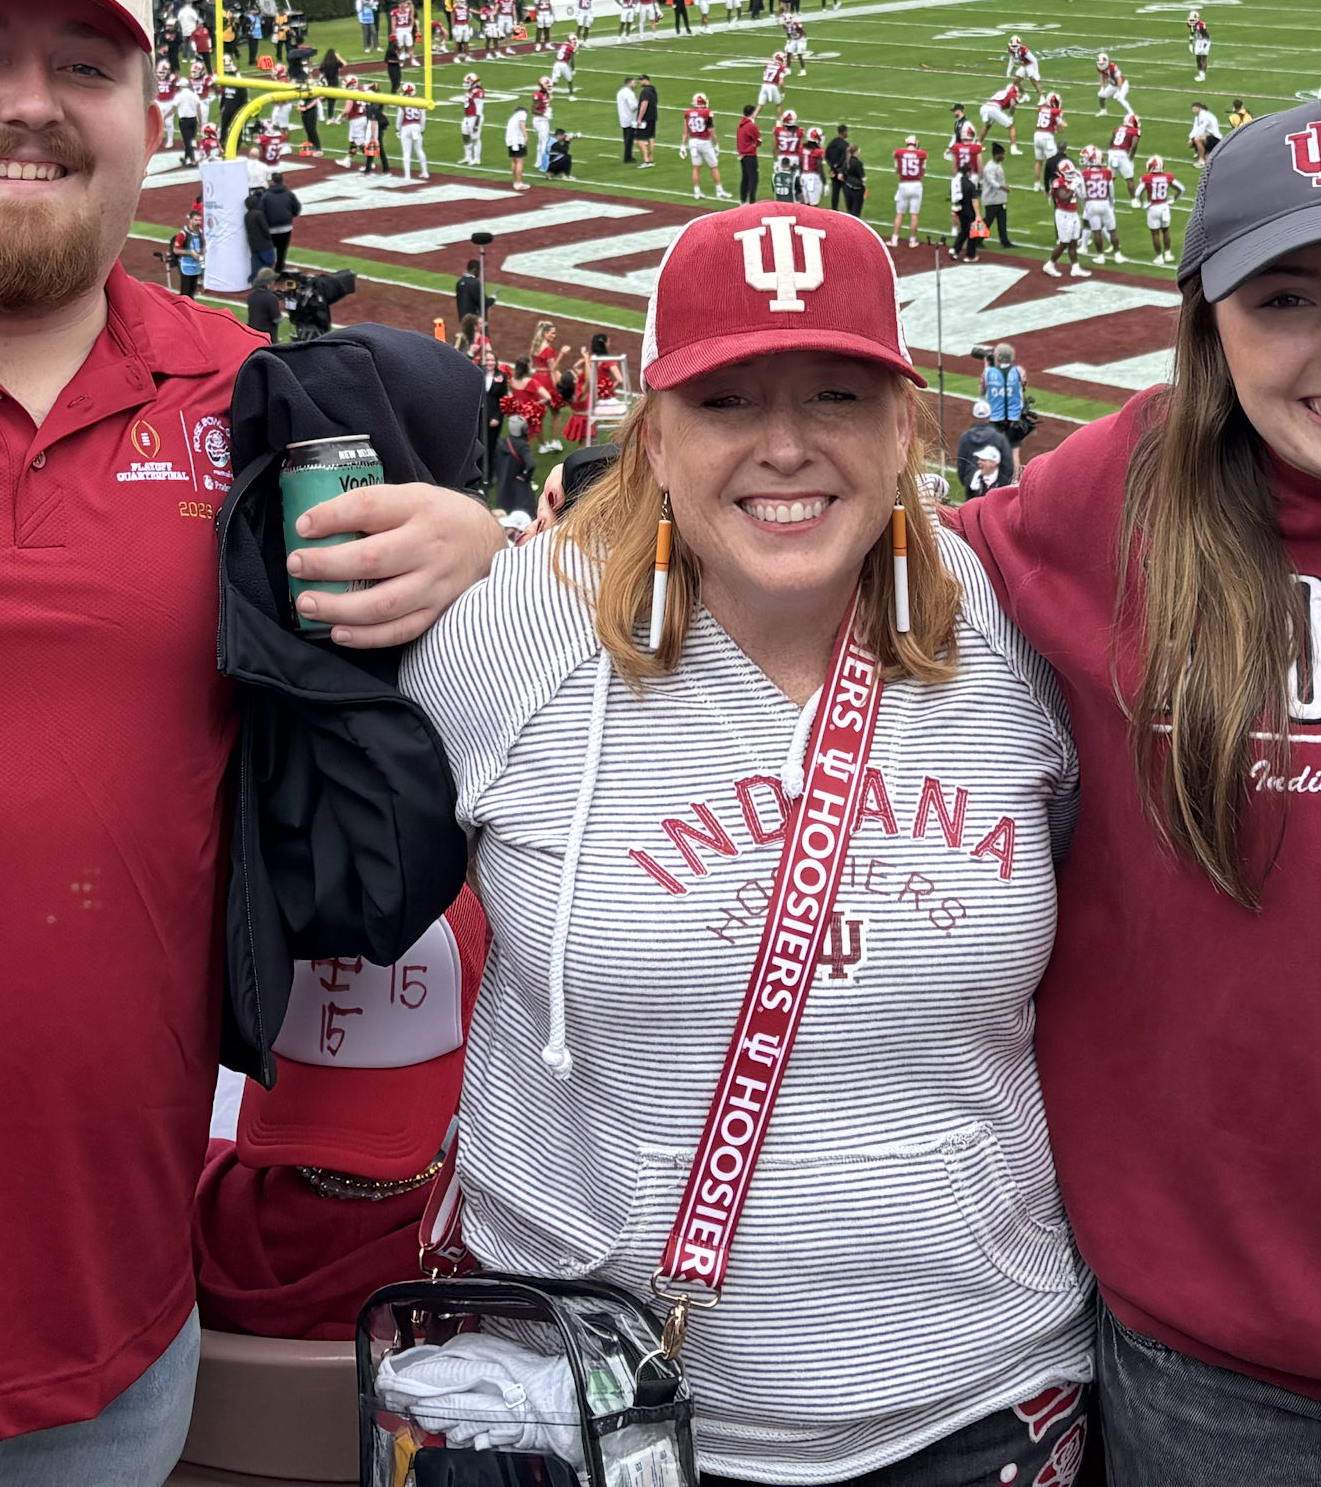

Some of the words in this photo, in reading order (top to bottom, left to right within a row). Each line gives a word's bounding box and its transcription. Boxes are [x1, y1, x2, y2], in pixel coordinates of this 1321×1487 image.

[778, 136, 798, 152] 37
[901, 158, 919, 177] 15
[1085, 180, 1108, 199] 28
[1151, 181, 1168, 200] 18
[339, 449, 356, 460] NEW
[130, 461, 173, 472] PLAYOFF
[116, 471, 190, 482] QUARTERFINAL
[628, 765, 1017, 897] INDANA
[706, 855, 968, 945] HOIERS
[760, 789, 848, 1014] HOOSIERS
